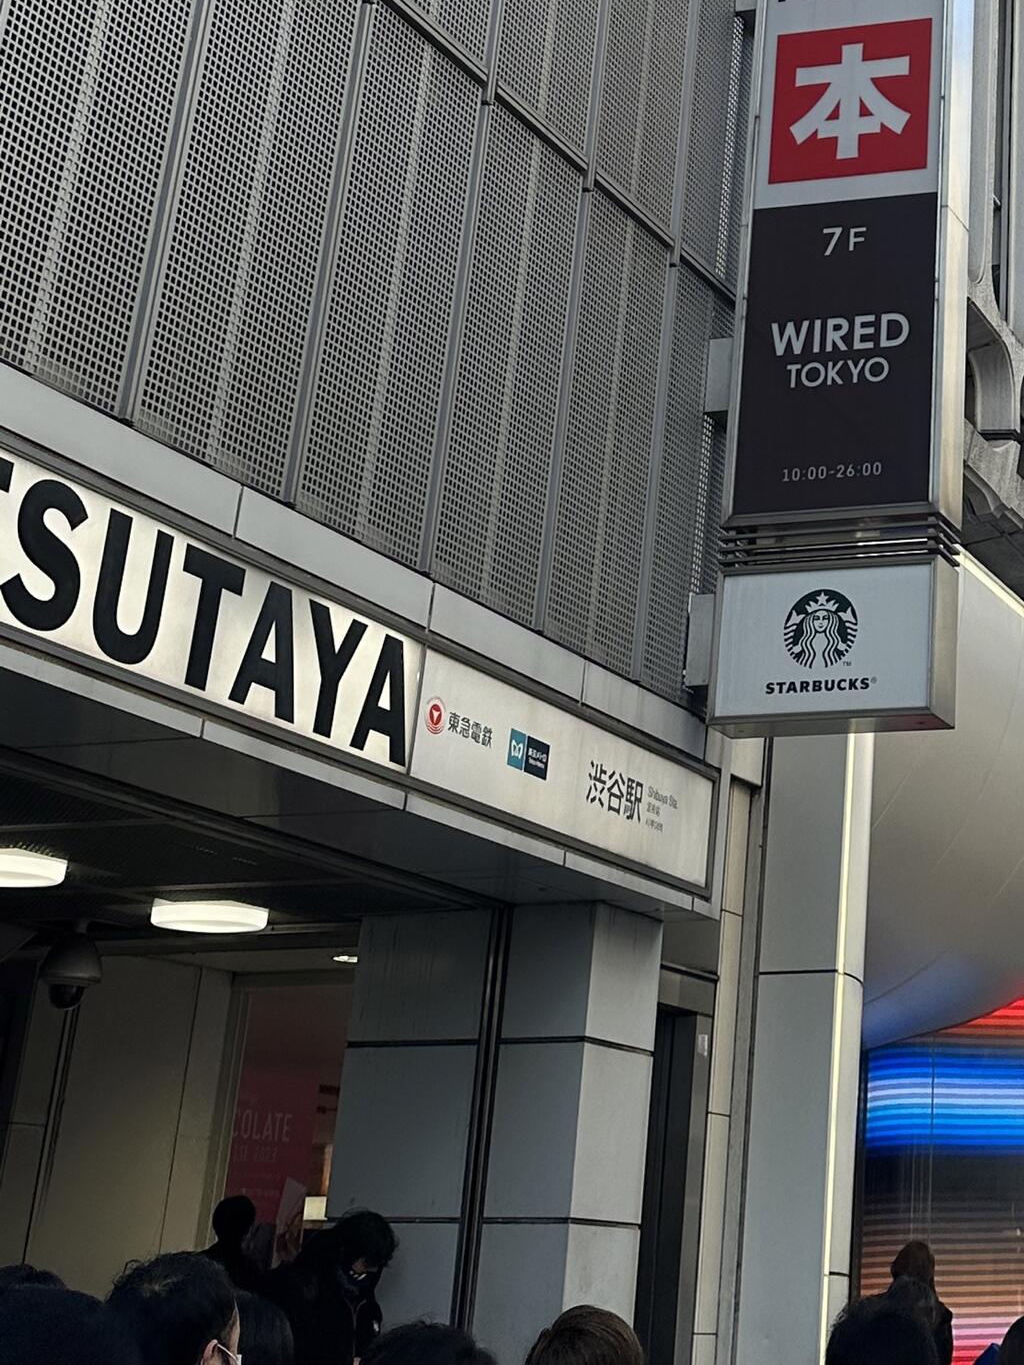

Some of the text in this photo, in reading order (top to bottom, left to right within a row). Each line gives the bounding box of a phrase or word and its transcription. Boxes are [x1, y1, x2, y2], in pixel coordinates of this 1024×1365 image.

[789, 42, 911, 160] 本
[822, 226, 867, 256] 7F
[771, 312, 910, 356] WIRED
[786, 356, 889, 388] TOKYO
[781, 461, 882, 482] 10:00-26:00
[0, 456, 407, 767] SUTAYA
[765, 677, 870, 695] STARBUCKS
[447, 711, 493, 748] 東急電鉄
[586, 760, 644, 822] 渋谷駅
